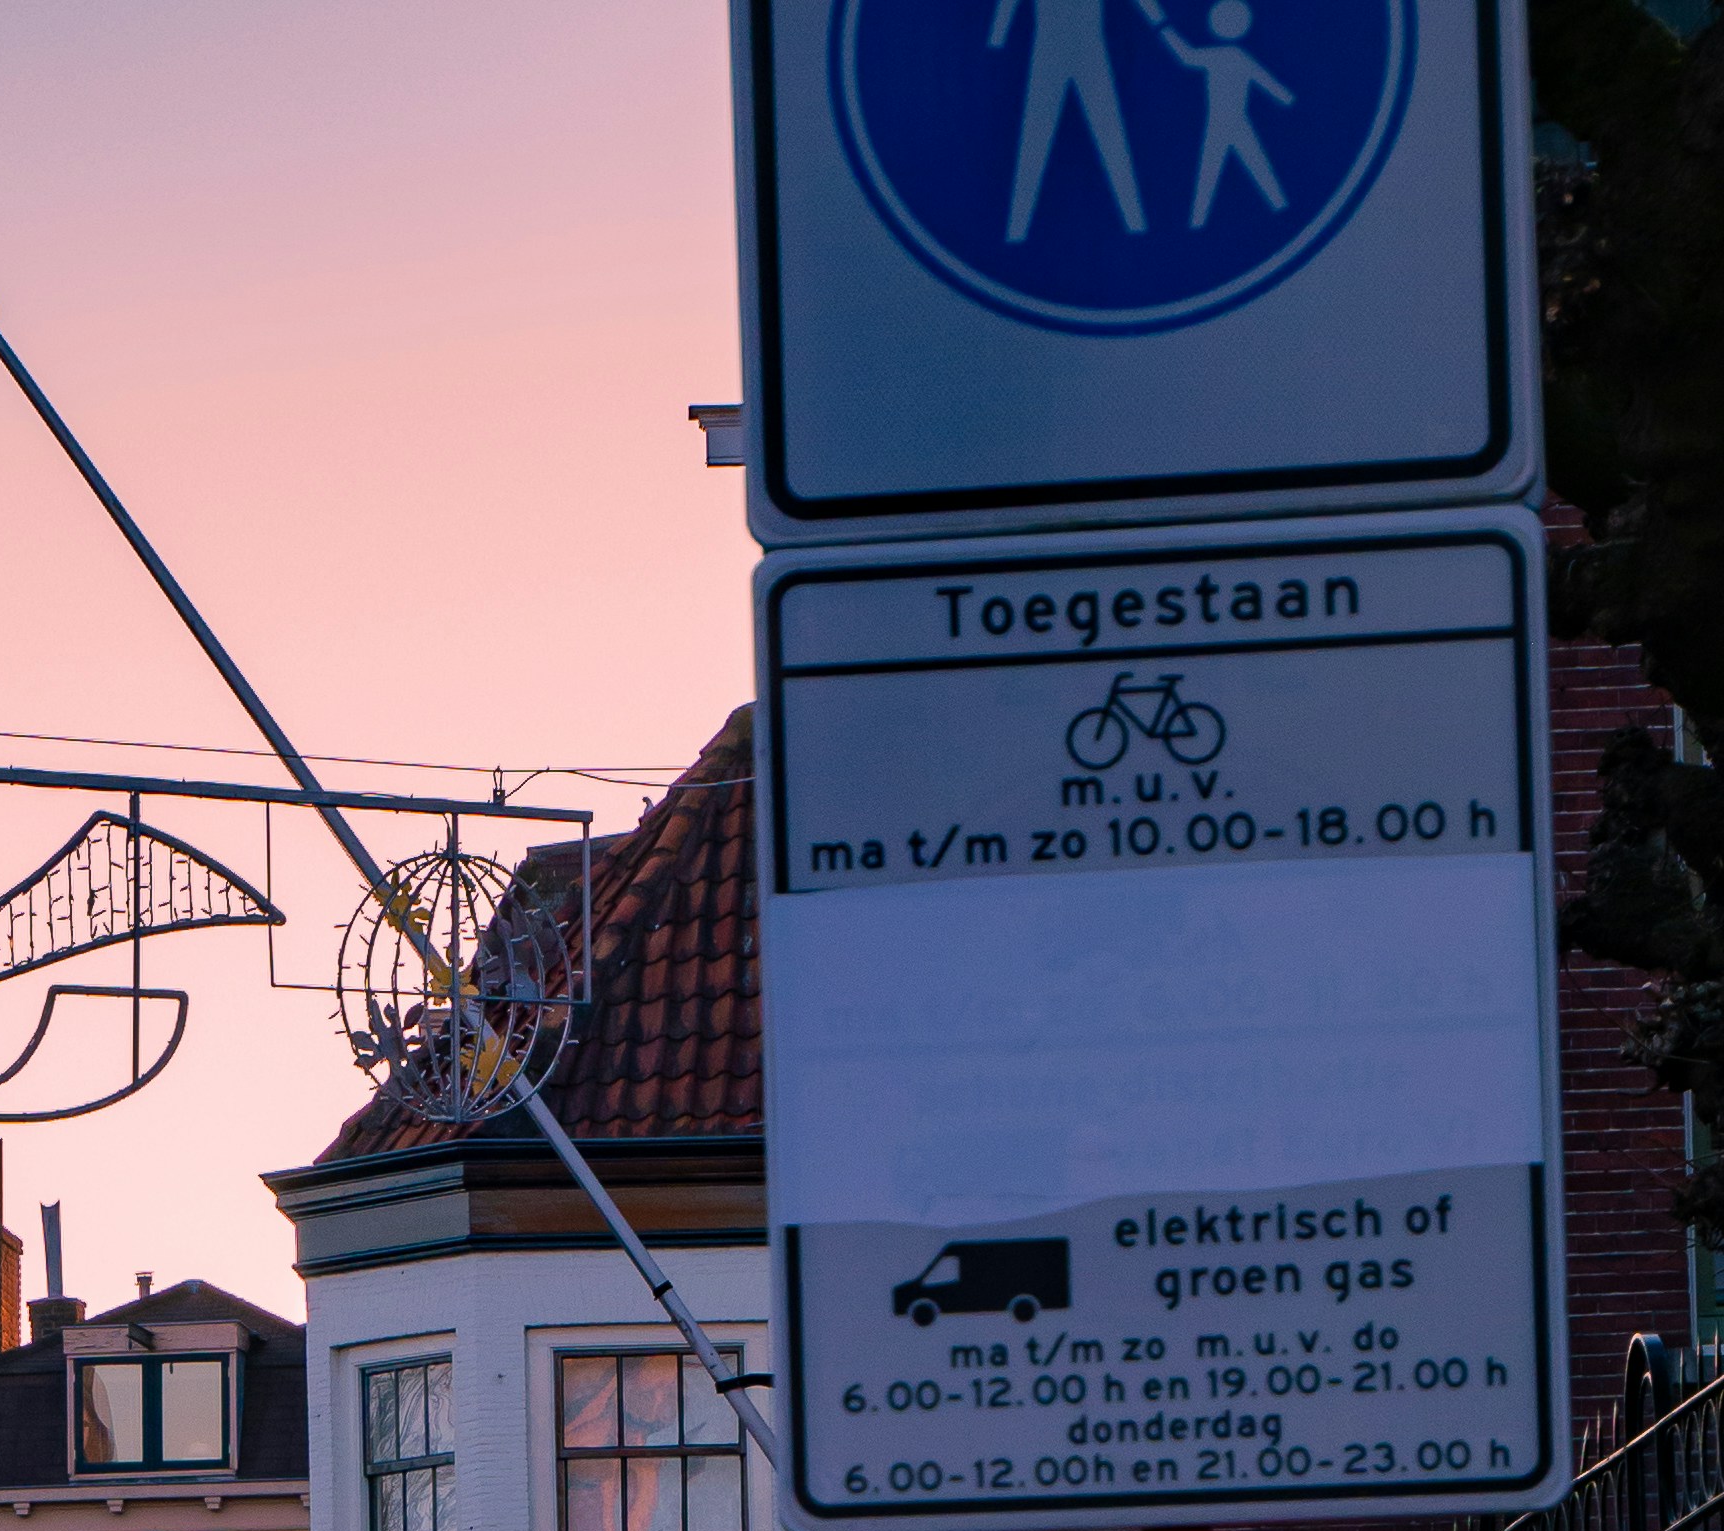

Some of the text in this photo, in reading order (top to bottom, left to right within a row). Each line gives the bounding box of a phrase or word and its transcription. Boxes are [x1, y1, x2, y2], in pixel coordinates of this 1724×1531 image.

[936, 574, 1361, 646] Toegestaan
[1062, 771, 1233, 807] m.u.v.
[812, 800, 1496, 871] ma t/m zo 10.00-18.00 h
[1115, 1195, 1453, 1248] elektrisch of
[1156, 1257, 1414, 1309] groen gas
[952, 1320, 1399, 1369] ma t/m zo m.u.v. do
[844, 1357, 1507, 1414] 6.00-12.00 h en 19.00-21.00 h
[1068, 1410, 1283, 1452] donderdag
[1133, 1456, 1178, 1483] en
[1197, 1441, 1471, 1480] 21.00-23.00
[1490, 1440, 1510, 1470] h
